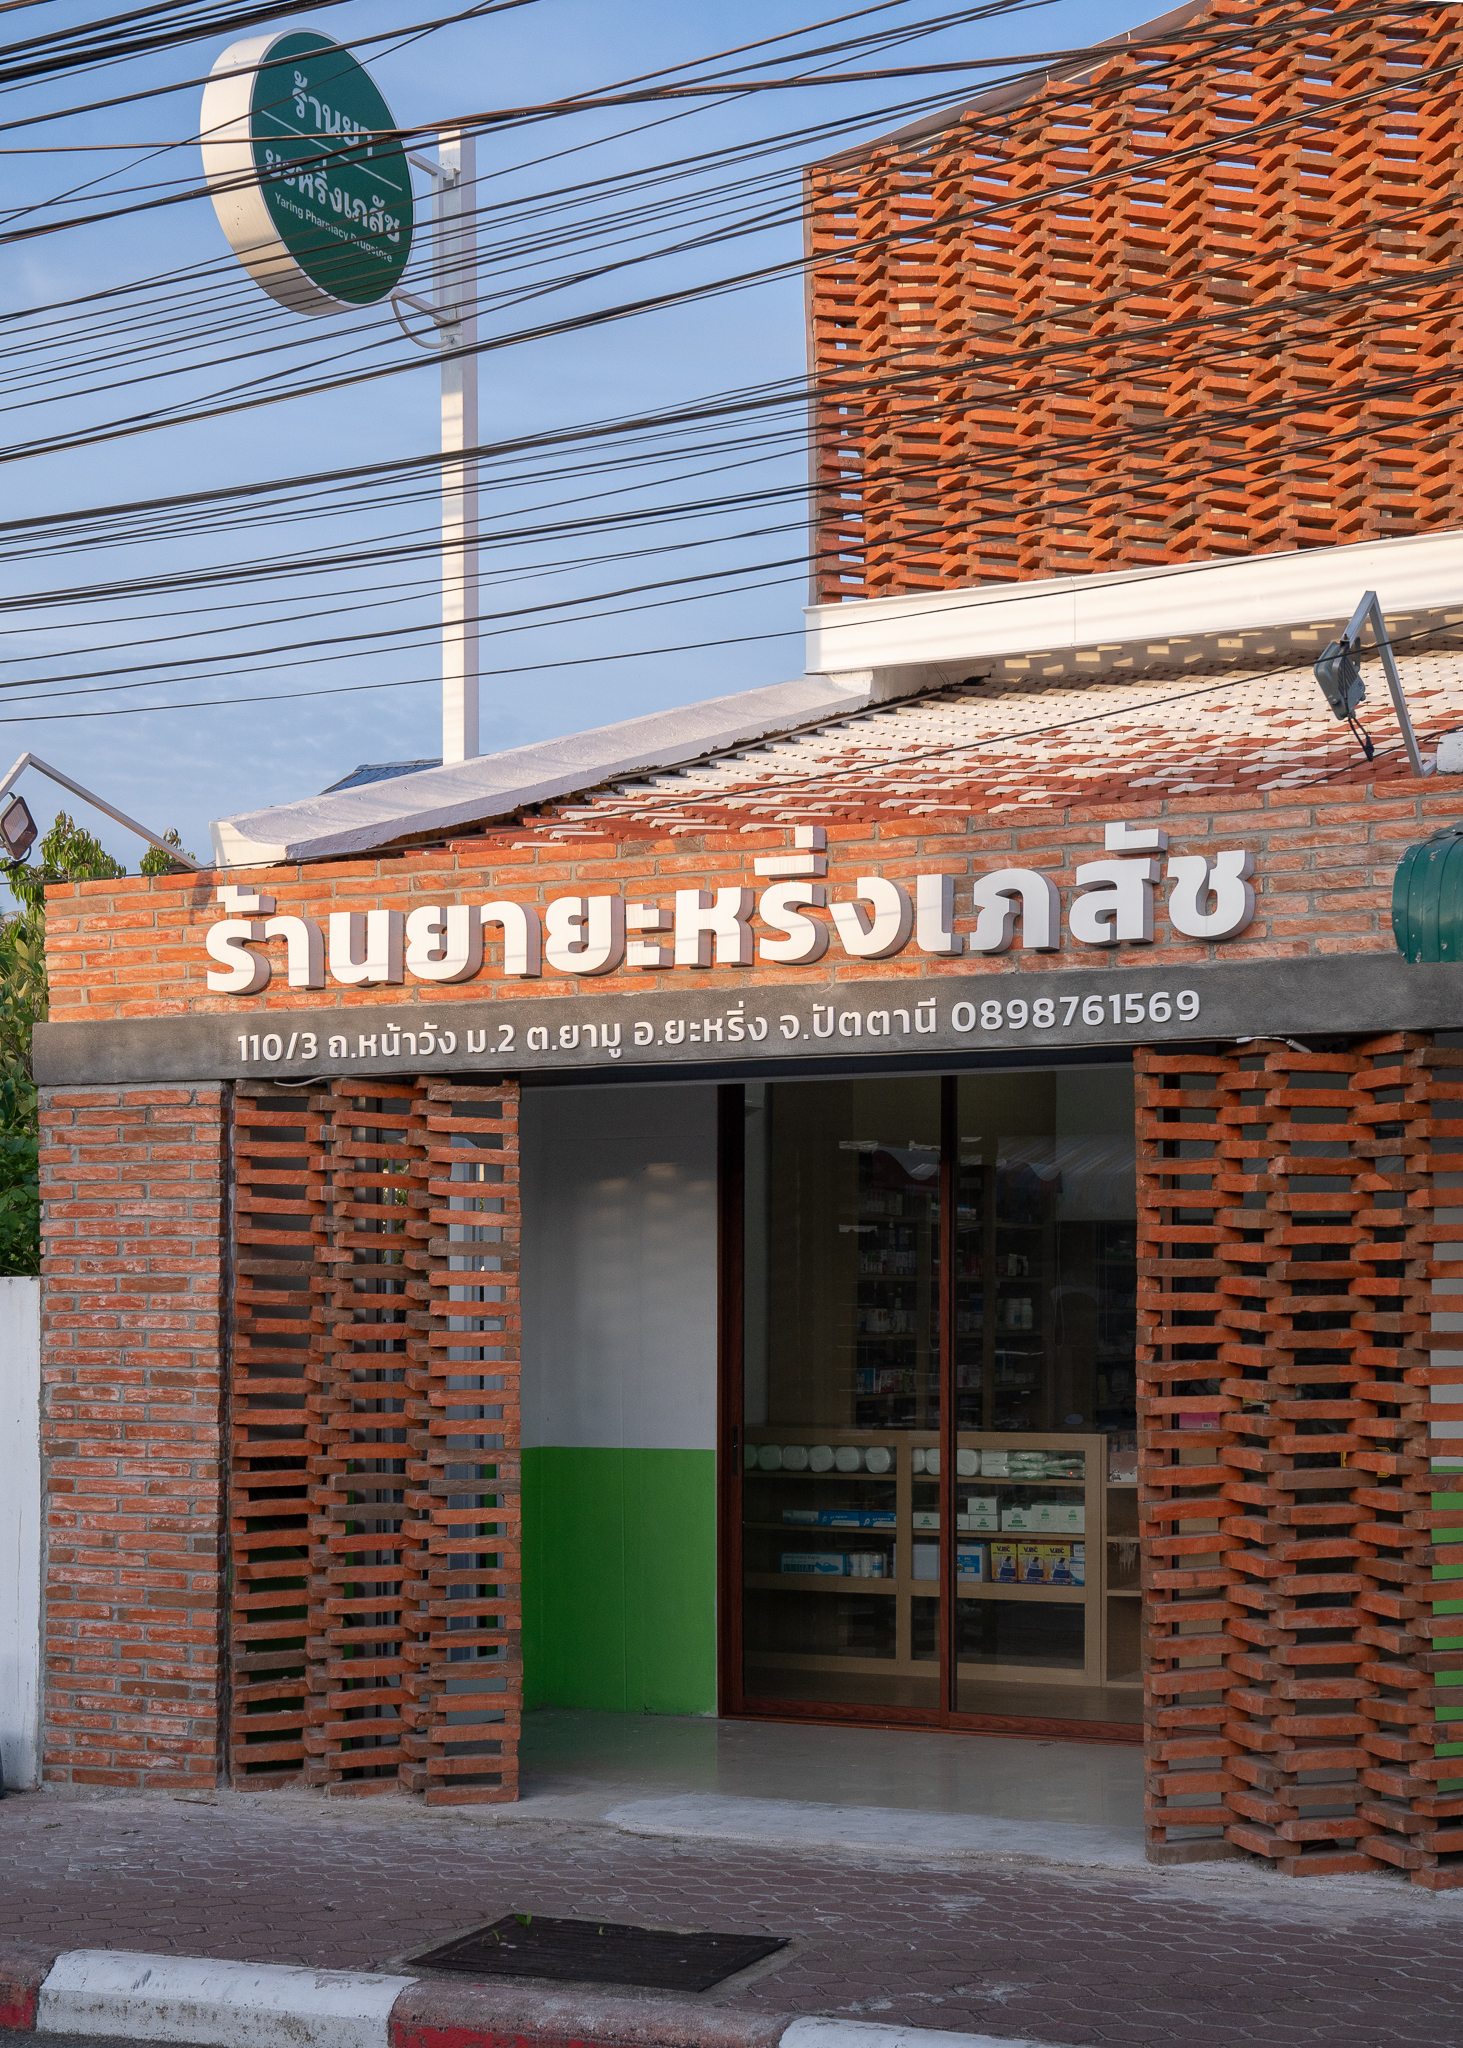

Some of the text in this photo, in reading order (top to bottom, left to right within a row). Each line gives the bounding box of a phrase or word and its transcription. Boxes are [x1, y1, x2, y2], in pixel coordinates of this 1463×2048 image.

[291, 70, 373, 157] ร้านยา
[274, 192, 304, 220] Yaring
[305, 208, 349, 241] Pharmacy
[237, 989, 1201, 1062] 110/3 ถ.หน้าวัง ม.2 ต.ยามู อ.ยะหริ่ง จ.ปัตตานี 0898761569
